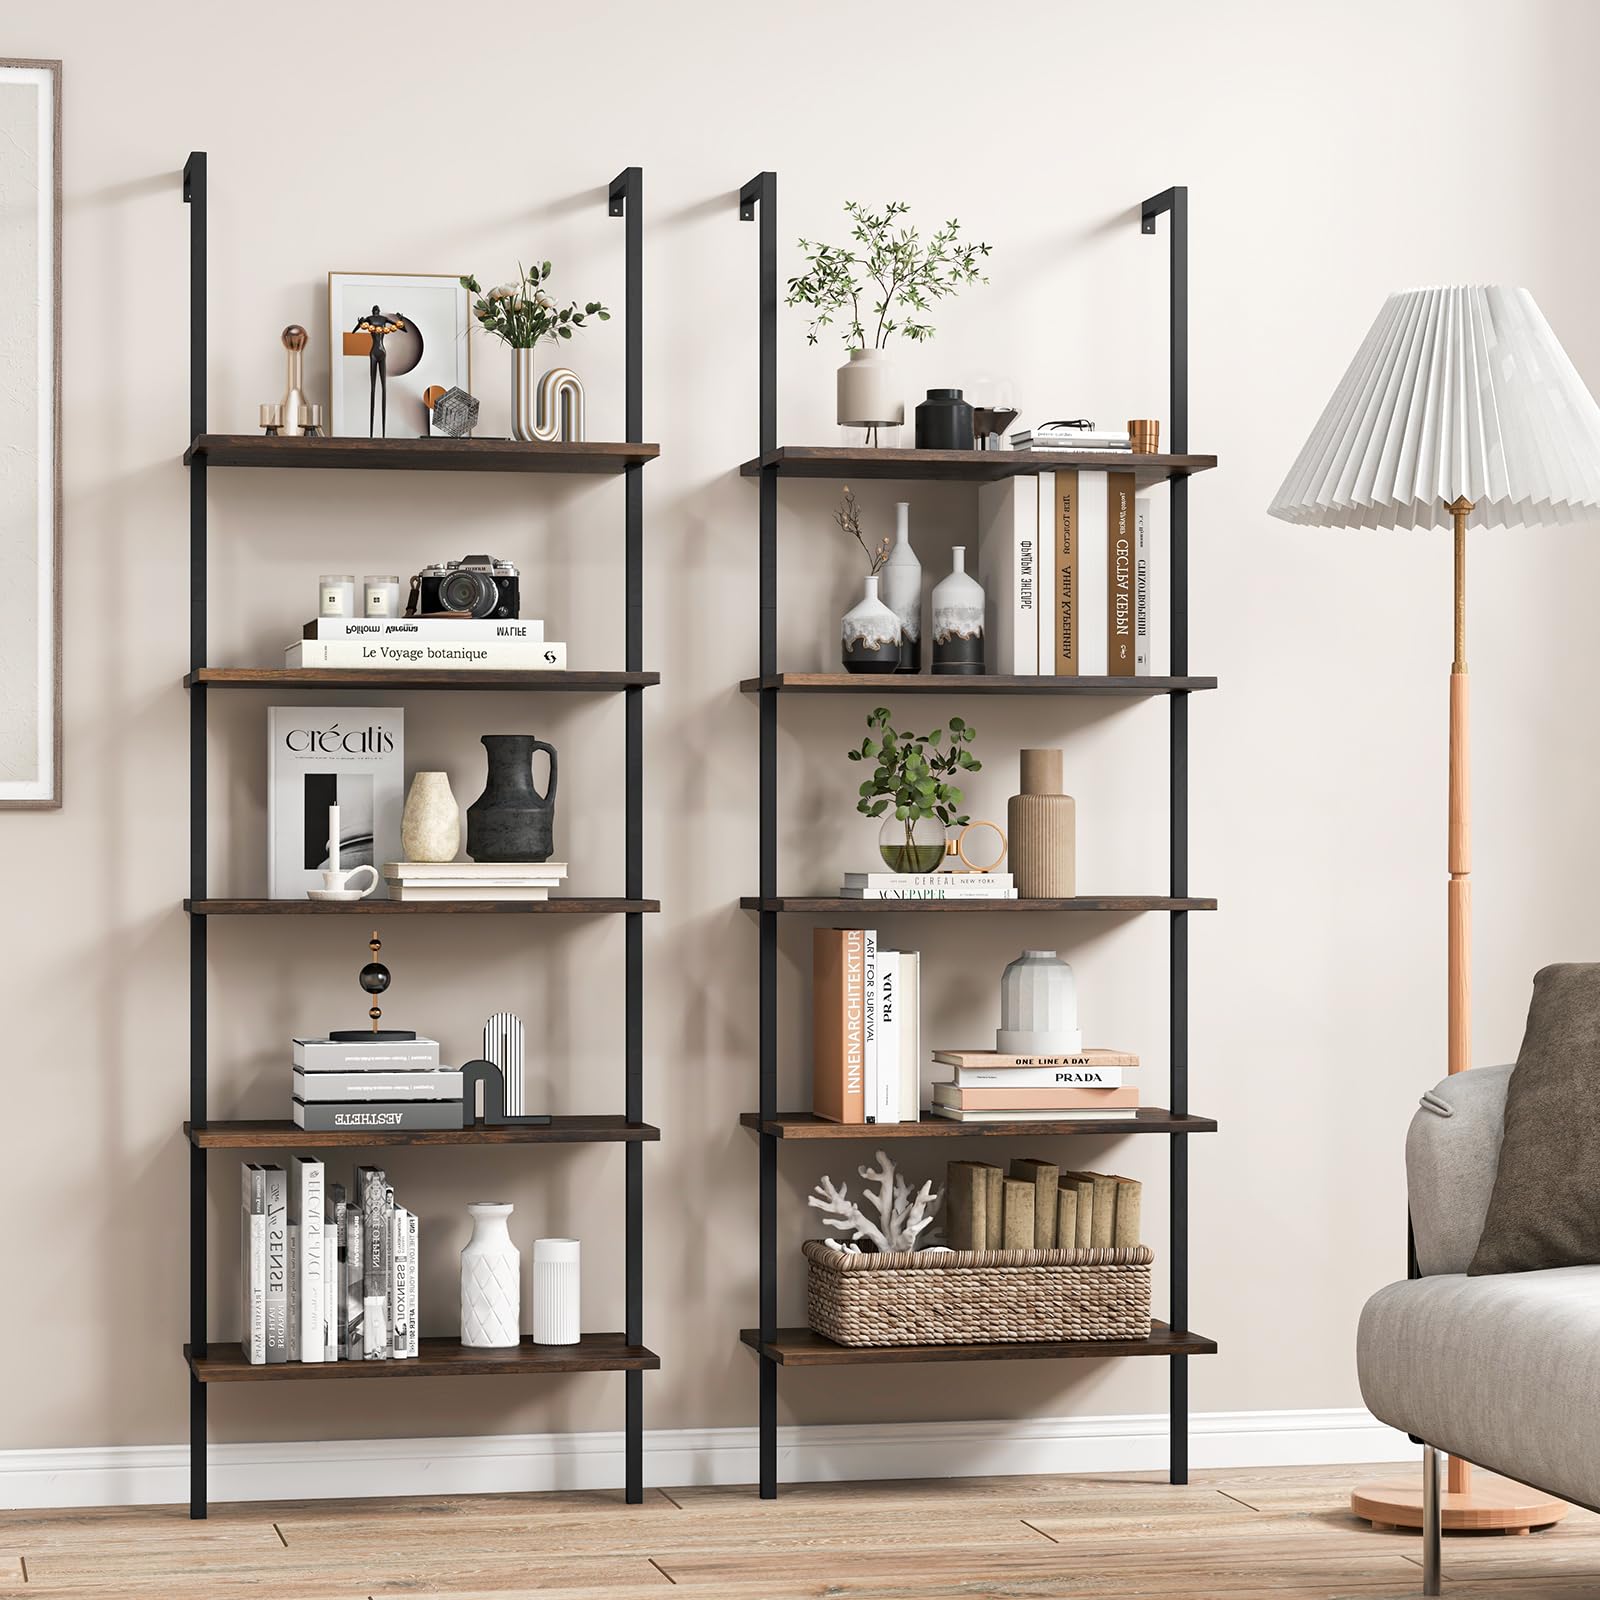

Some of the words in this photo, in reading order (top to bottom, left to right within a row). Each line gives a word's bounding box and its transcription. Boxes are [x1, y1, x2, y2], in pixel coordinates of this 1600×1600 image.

[362, 646, 377, 658] Le
[380, 646, 424, 662] Voyage
[427, 646, 488, 662] botanique
[914, 876, 956, 886] CEREAL
[866, 938, 875, 959] ART
[866, 964, 875, 987] FOR
[883, 972, 892, 1022] PRADA
[848, 930, 861, 1094] INNENARCHITEKTUR
[866, 991, 875, 1042] SURVIVAL
[1055, 1073, 1102, 1082] PRADA
[335, 1112, 403, 1125] AESTHETE
